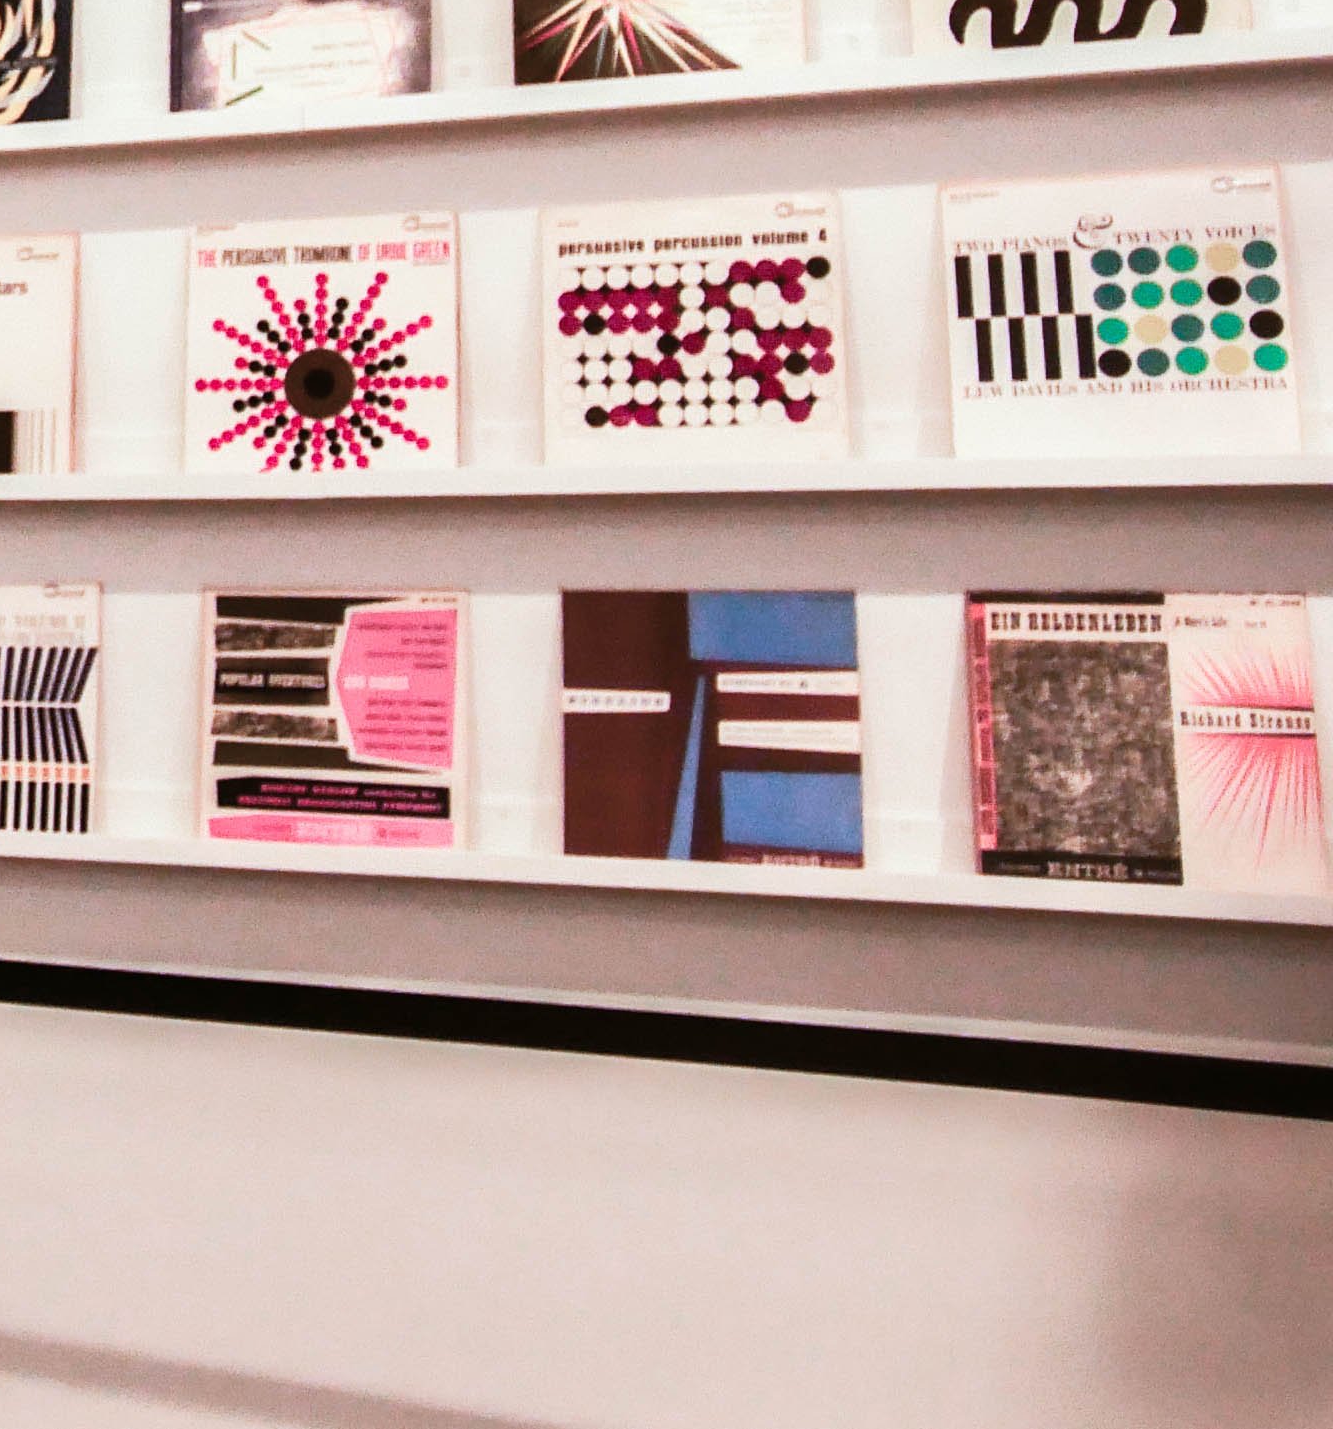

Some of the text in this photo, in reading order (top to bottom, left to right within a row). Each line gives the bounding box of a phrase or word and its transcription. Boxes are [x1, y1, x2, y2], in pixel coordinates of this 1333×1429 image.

[558, 239, 645, 257] persuasive
[654, 233, 743, 253] percussion
[752, 229, 809, 245] volume
[991, 611, 1022, 631] EIN
[1179, 710, 1242, 728] Richard
